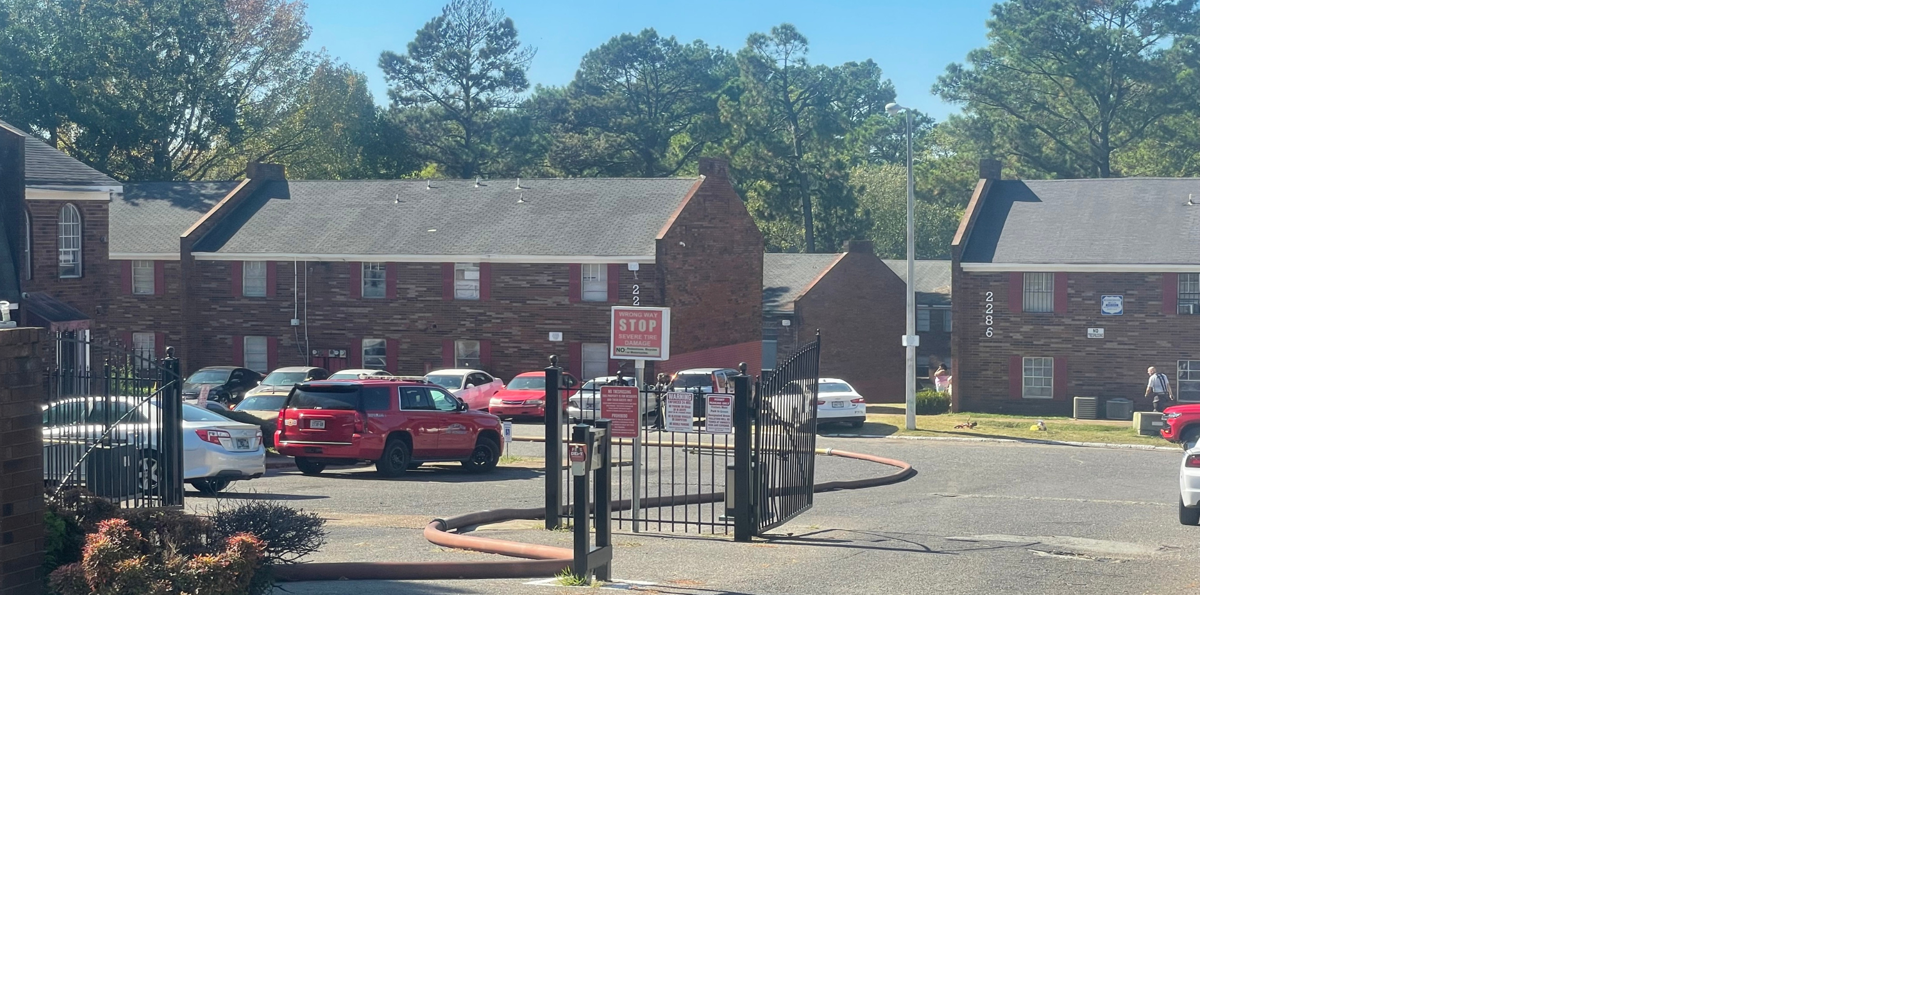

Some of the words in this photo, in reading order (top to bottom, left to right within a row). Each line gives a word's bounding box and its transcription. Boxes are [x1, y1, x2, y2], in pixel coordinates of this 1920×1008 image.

[985, 291, 994, 338] 2286
[619, 319, 657, 333] STOP
[644, 333, 658, 341] TIRE
